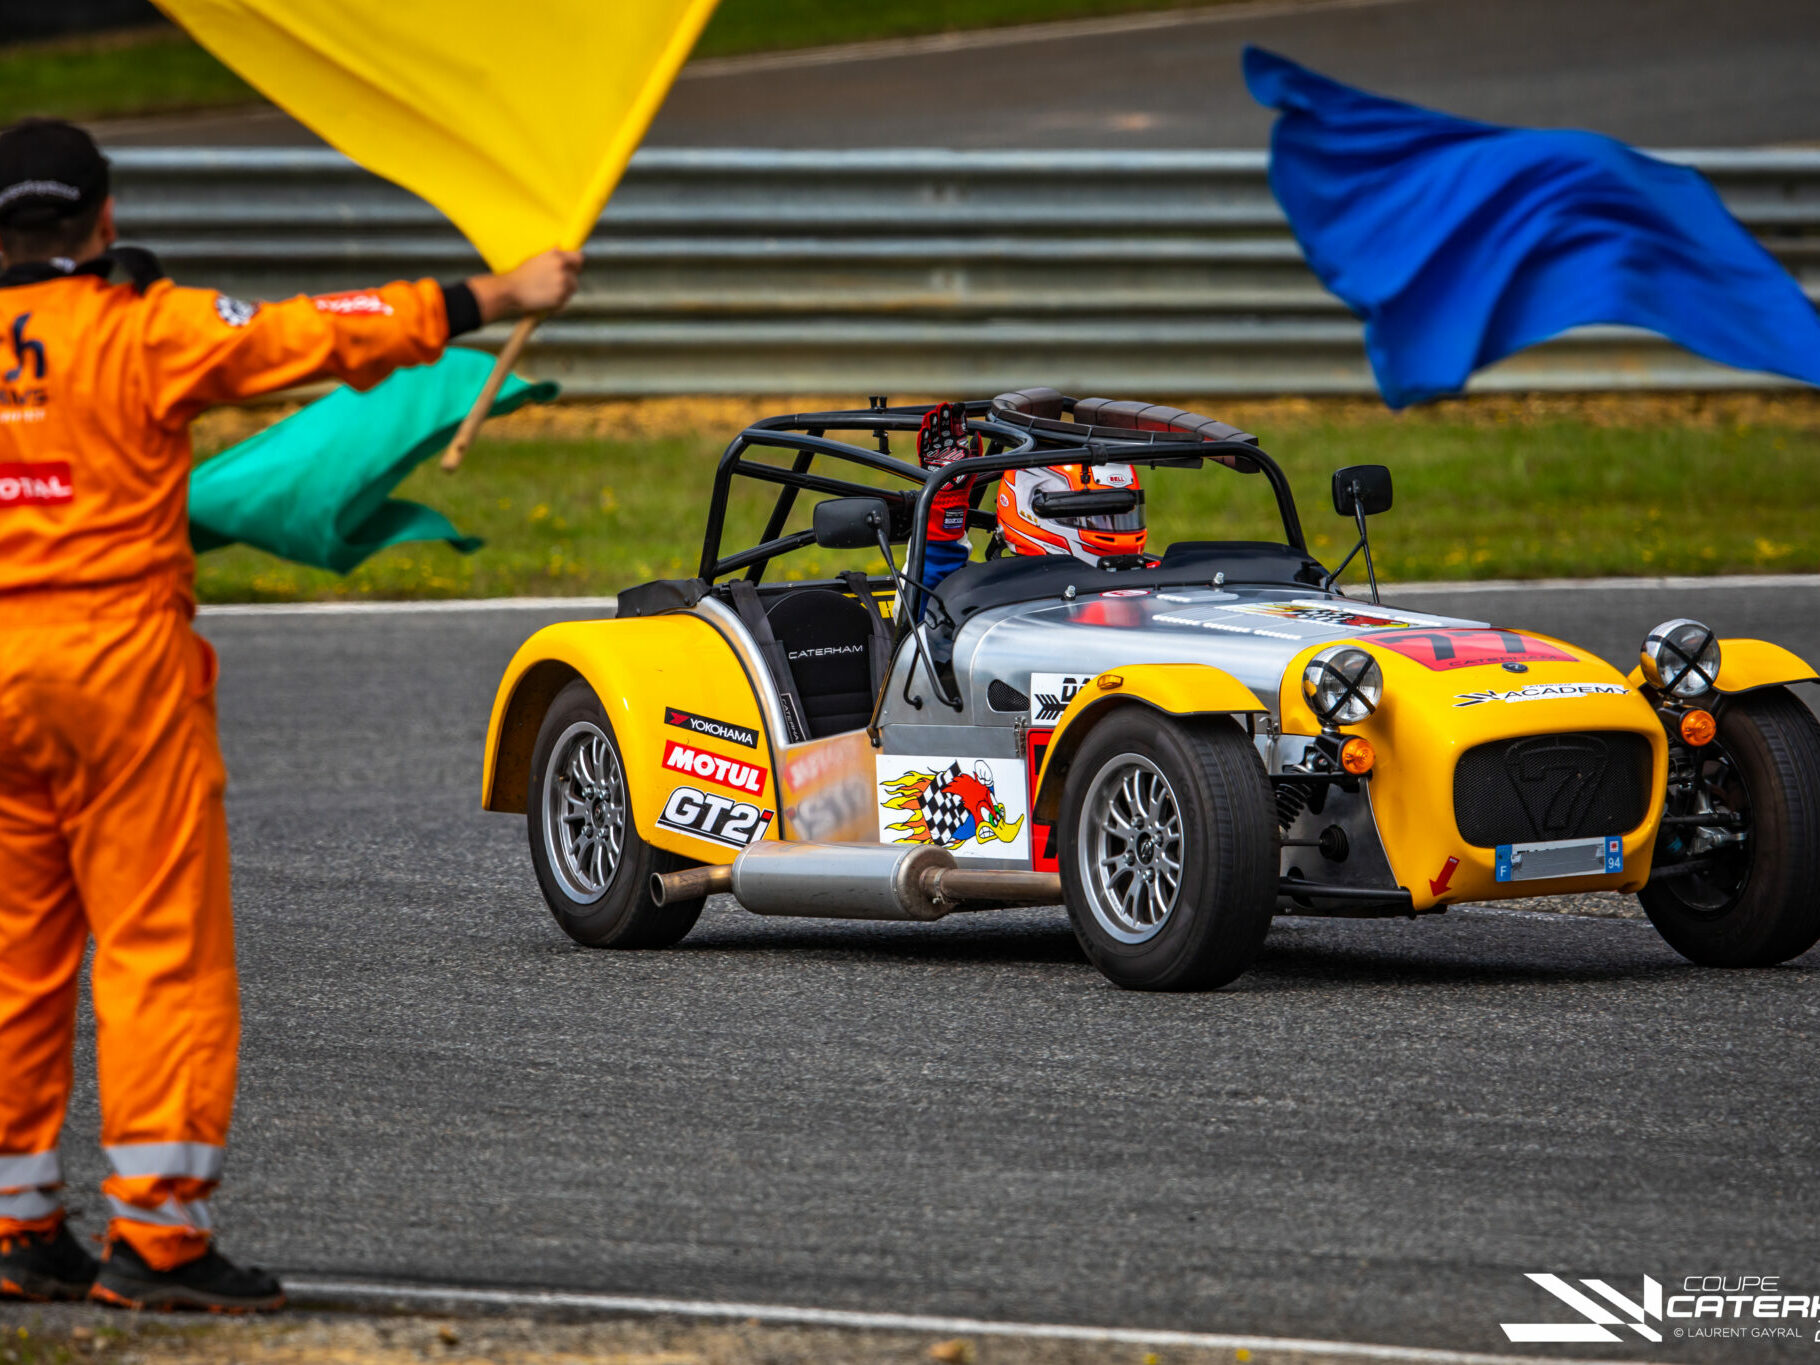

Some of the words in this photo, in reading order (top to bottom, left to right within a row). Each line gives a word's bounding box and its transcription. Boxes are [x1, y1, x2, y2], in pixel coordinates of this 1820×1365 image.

[788, 645, 863, 660] CATERHAM
[1375, 630, 1527, 661] 77
[1504, 686, 1631, 699] ACADEMY
[690, 718, 754, 745] YOKOHAMA
[781, 698, 800, 743] CATERHA
[667, 746, 760, 792] MOTUL
[662, 786, 774, 843] GT2i
[1500, 865, 1507, 877] F
[1608, 857, 1620, 869] 94
